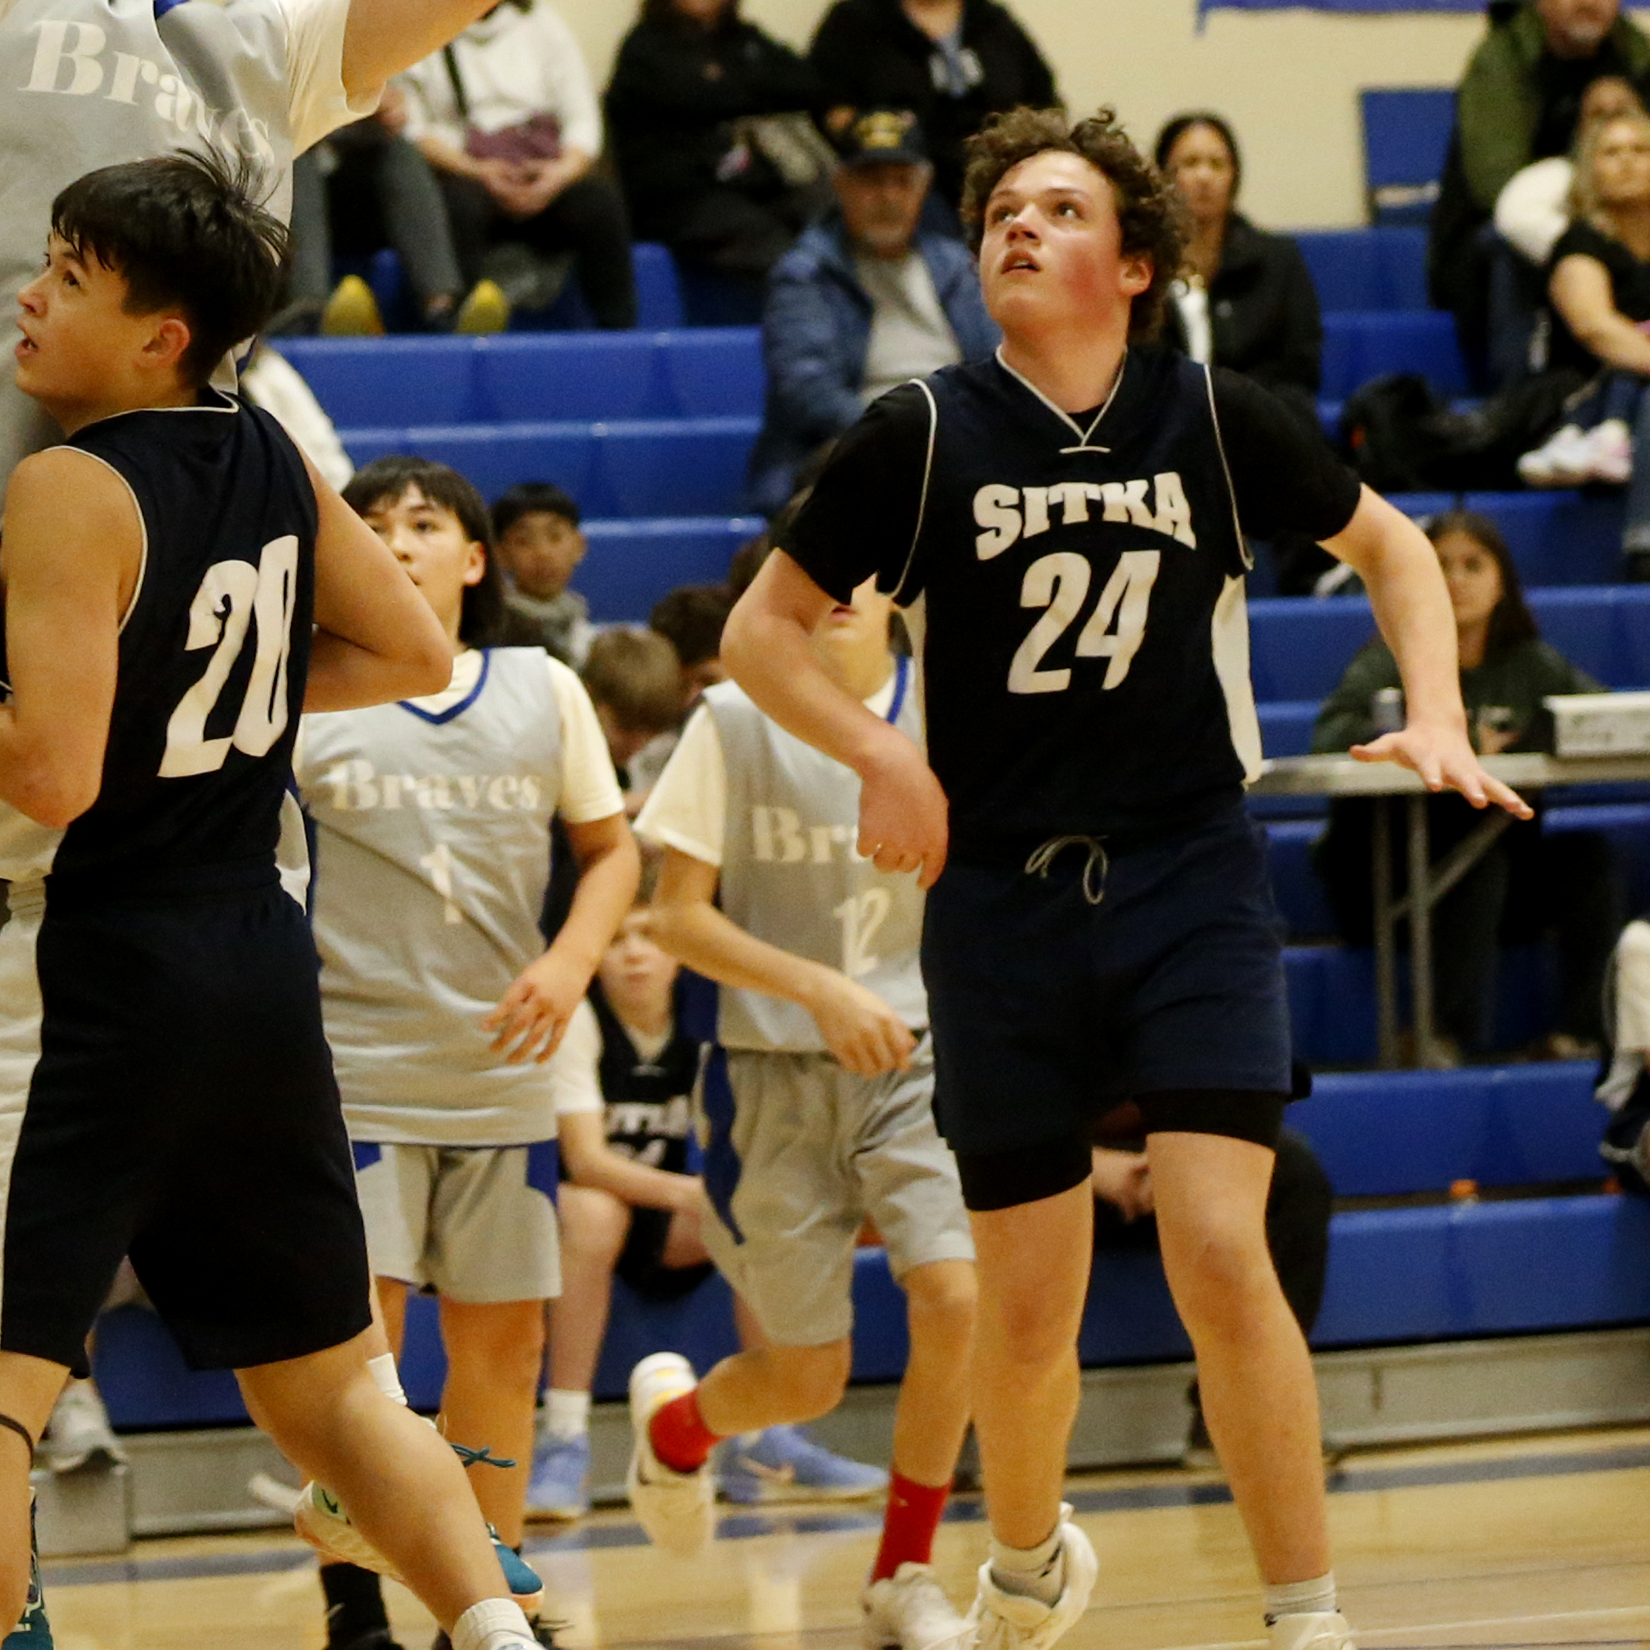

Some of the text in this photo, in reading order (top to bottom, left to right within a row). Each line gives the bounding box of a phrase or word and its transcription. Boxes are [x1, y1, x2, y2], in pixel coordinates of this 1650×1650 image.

[973, 471, 1197, 561] SITKA
[157, 534, 299, 779] 20
[1007, 550, 1161, 694] 24
[330, 758, 541, 811] Braves
[833, 887, 891, 978] 12
